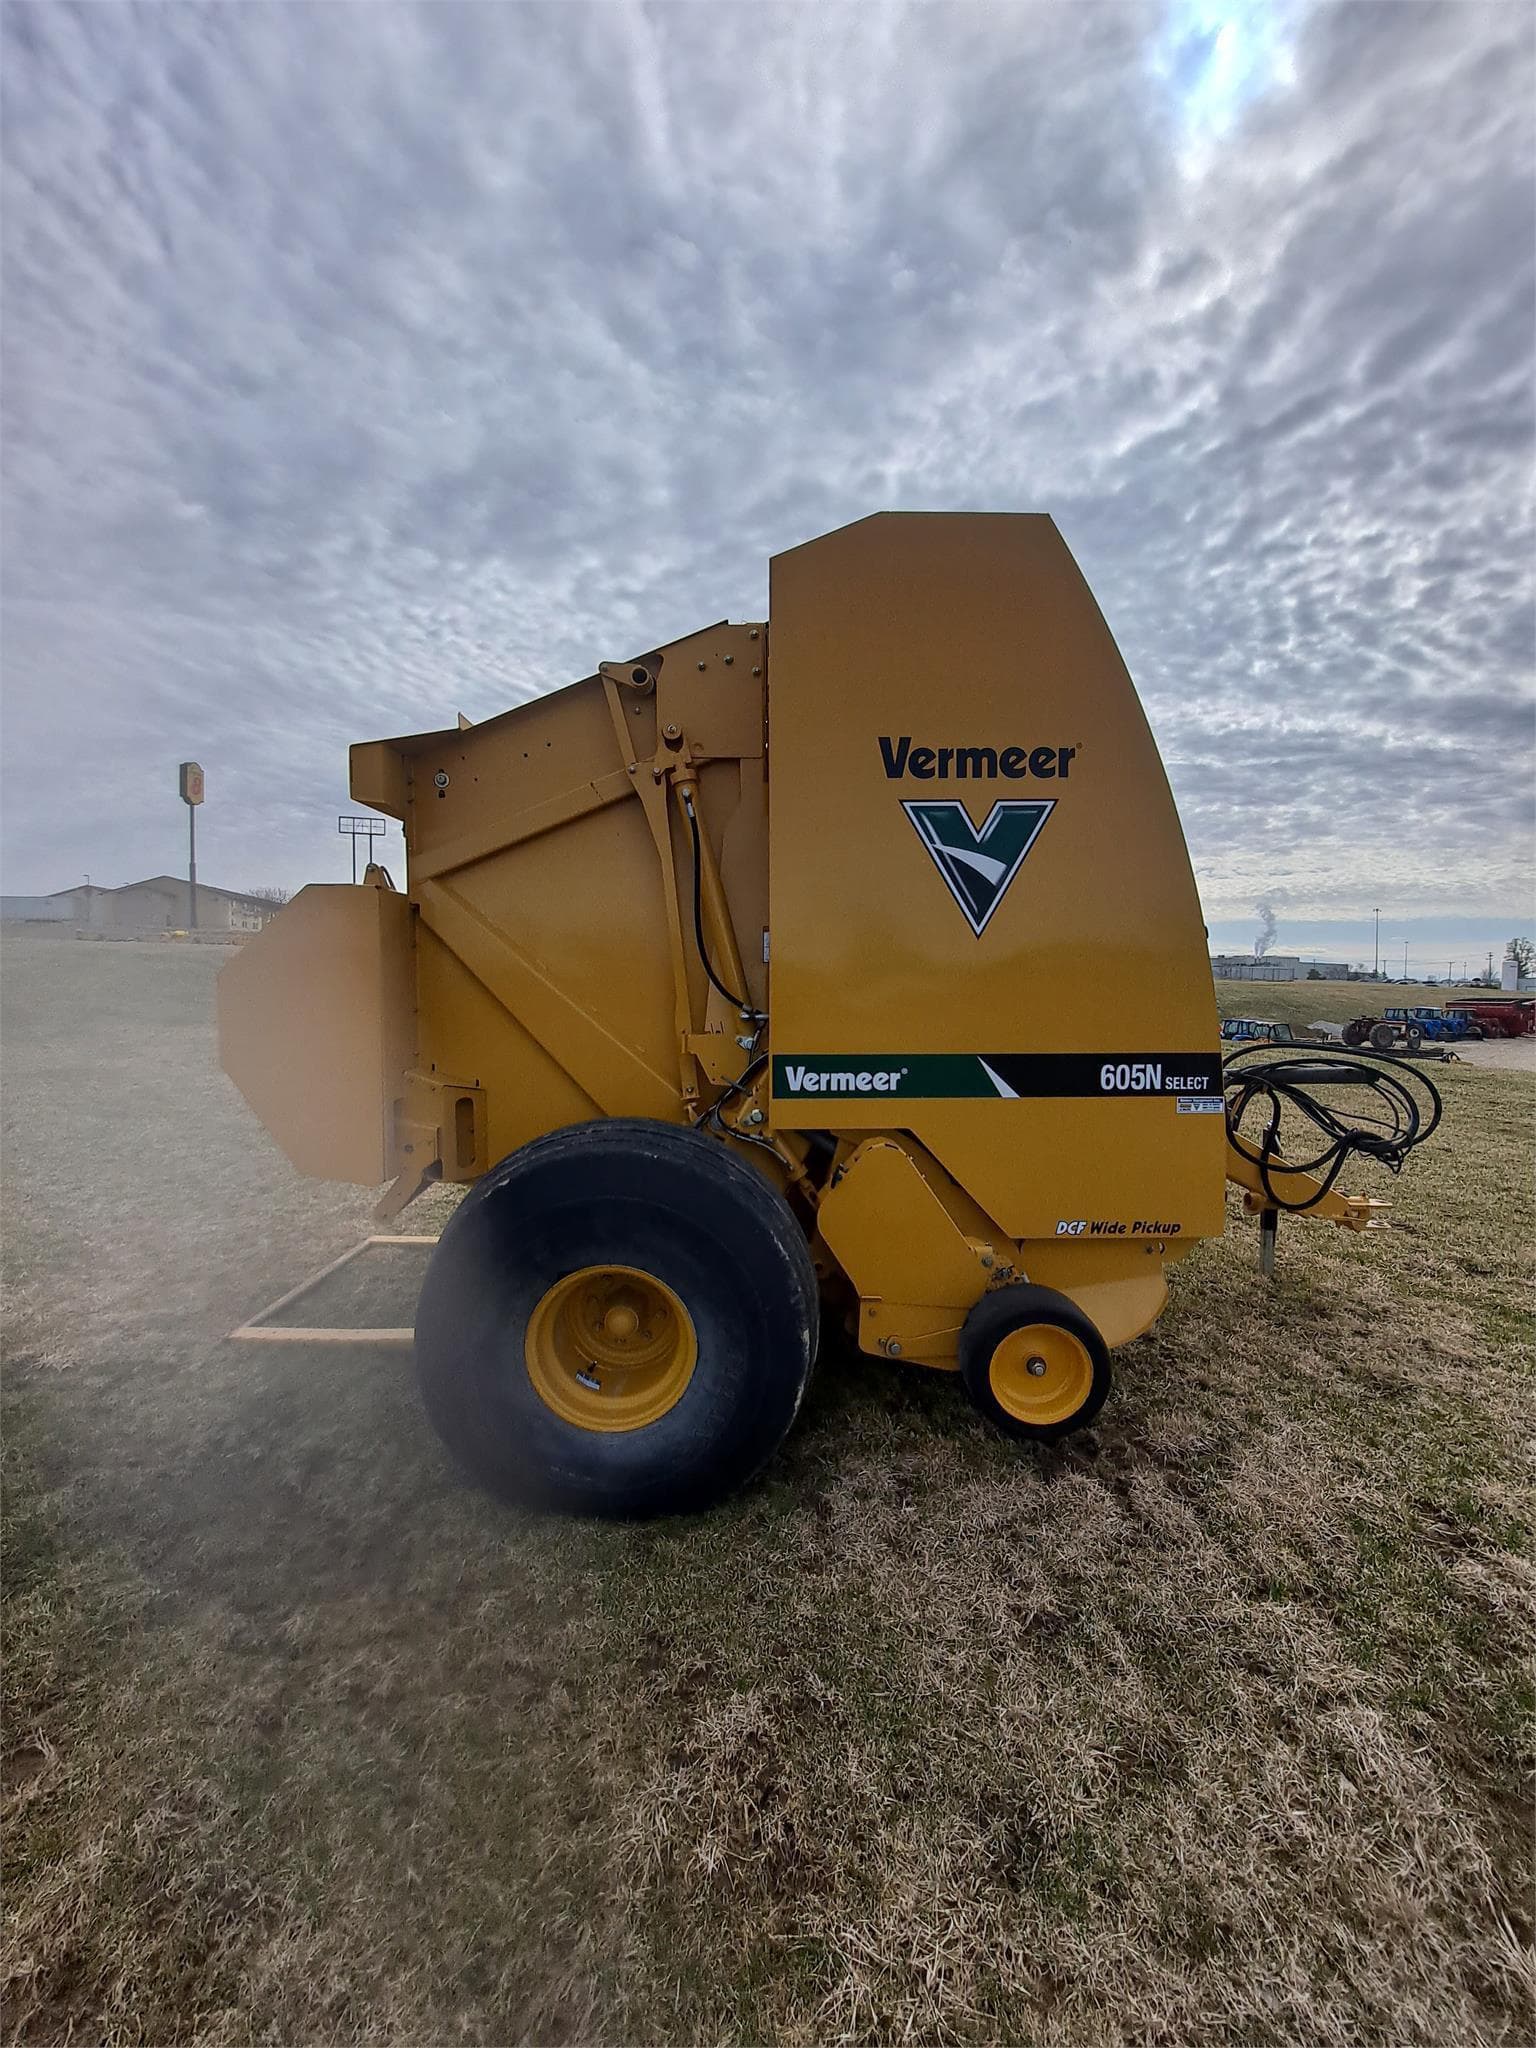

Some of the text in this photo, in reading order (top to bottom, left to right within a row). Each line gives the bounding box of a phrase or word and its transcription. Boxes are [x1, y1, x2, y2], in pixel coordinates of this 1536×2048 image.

[878, 736, 1076, 779] Vermeer
[785, 1066, 901, 1092] Vermeer
[1100, 1064, 1209, 1090] 605N SELECT
[1056, 1220, 1181, 1236] DCF Wide Pickup
